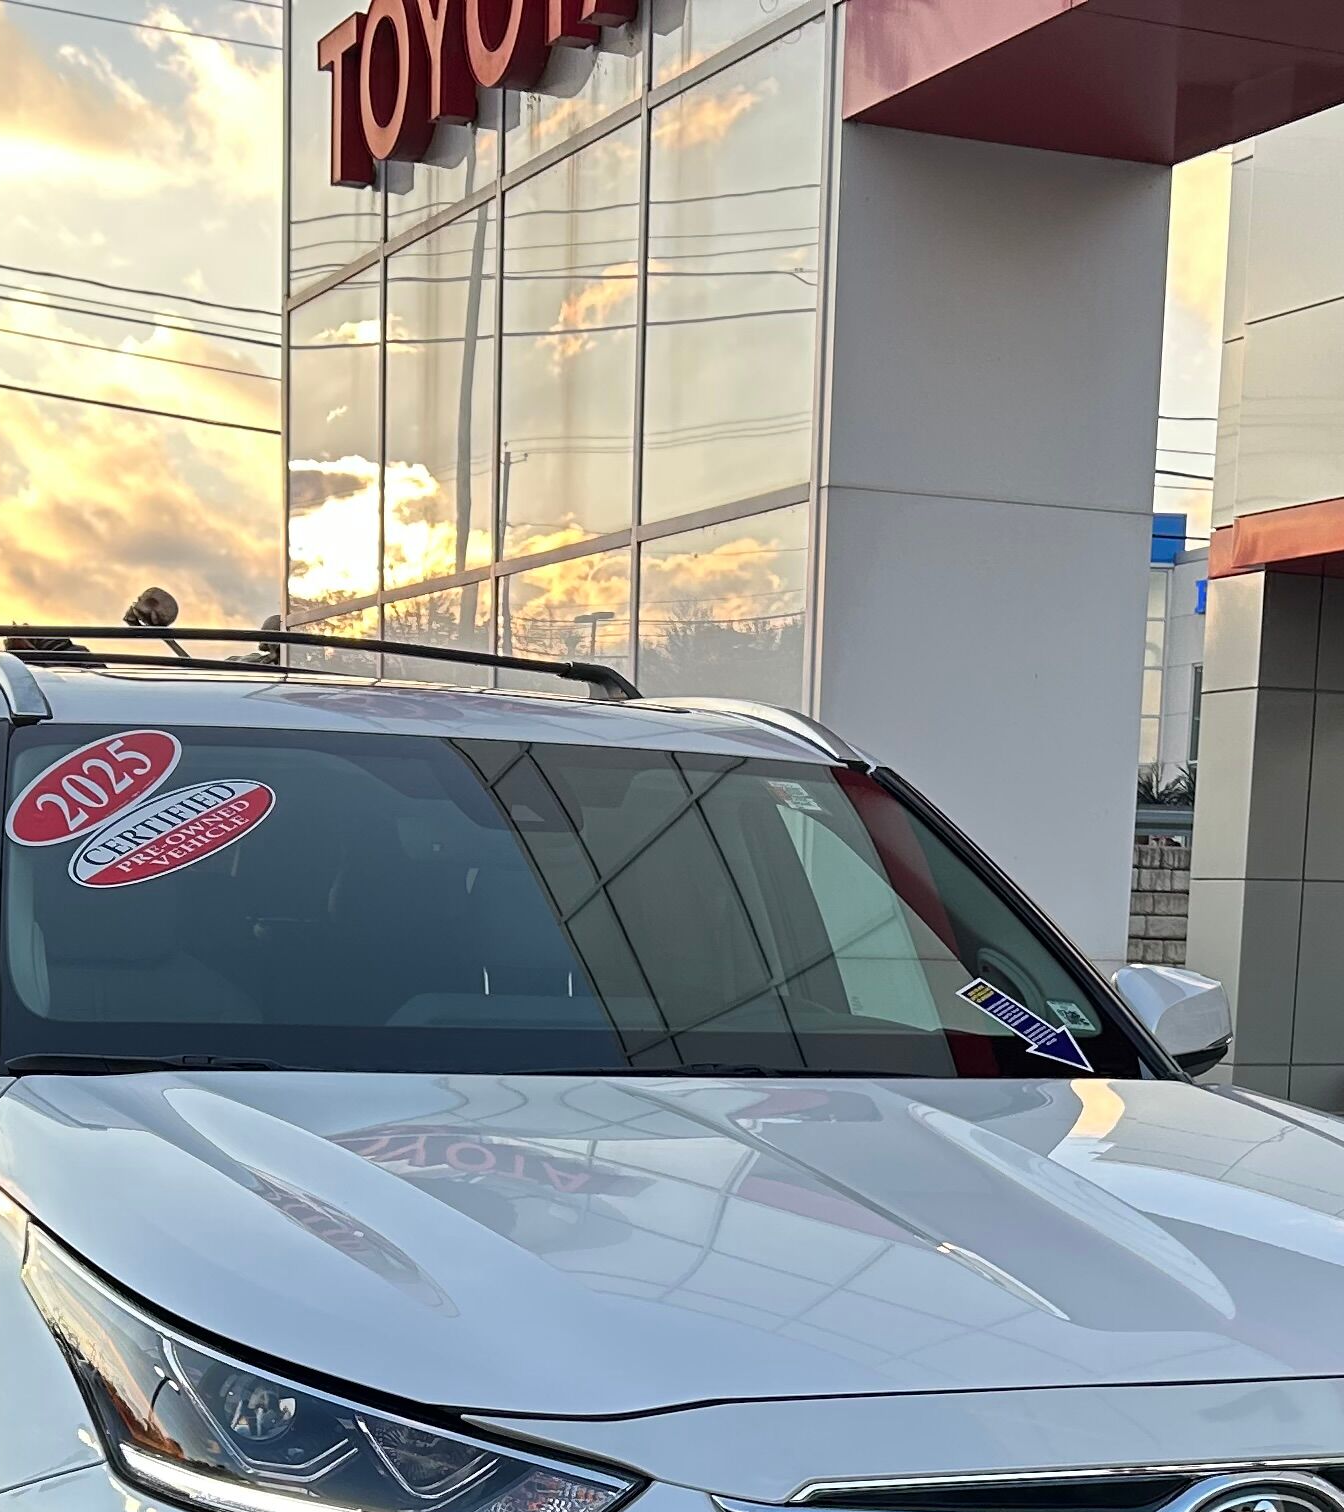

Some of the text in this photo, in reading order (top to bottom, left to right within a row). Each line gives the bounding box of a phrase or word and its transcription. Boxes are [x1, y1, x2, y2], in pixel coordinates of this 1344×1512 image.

[318, 0, 638, 188] TOYO
[36, 739, 152, 831] 2025
[81, 784, 237, 866] CERTIFIED
[115, 800, 250, 873] PRE-OWNED
[151, 815, 250, 867] VEHICLE
